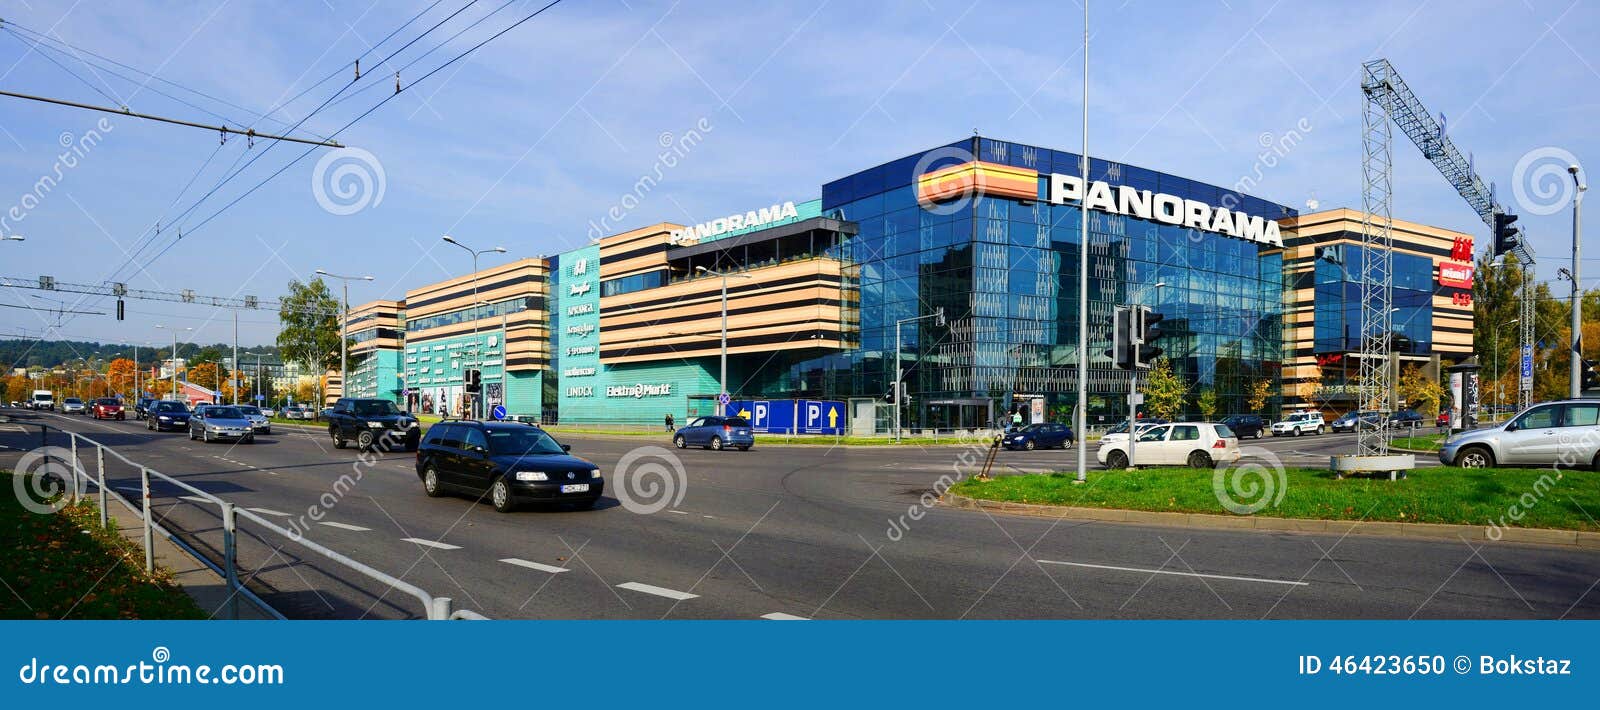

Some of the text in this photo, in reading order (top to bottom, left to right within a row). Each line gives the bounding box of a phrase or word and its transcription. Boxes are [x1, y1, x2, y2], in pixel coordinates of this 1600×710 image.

[670, 201, 798, 245] PANORAMA
[1051, 173, 1284, 248] PANORAMA
[755, 405, 767, 426] P
[808, 405, 820, 427] P
